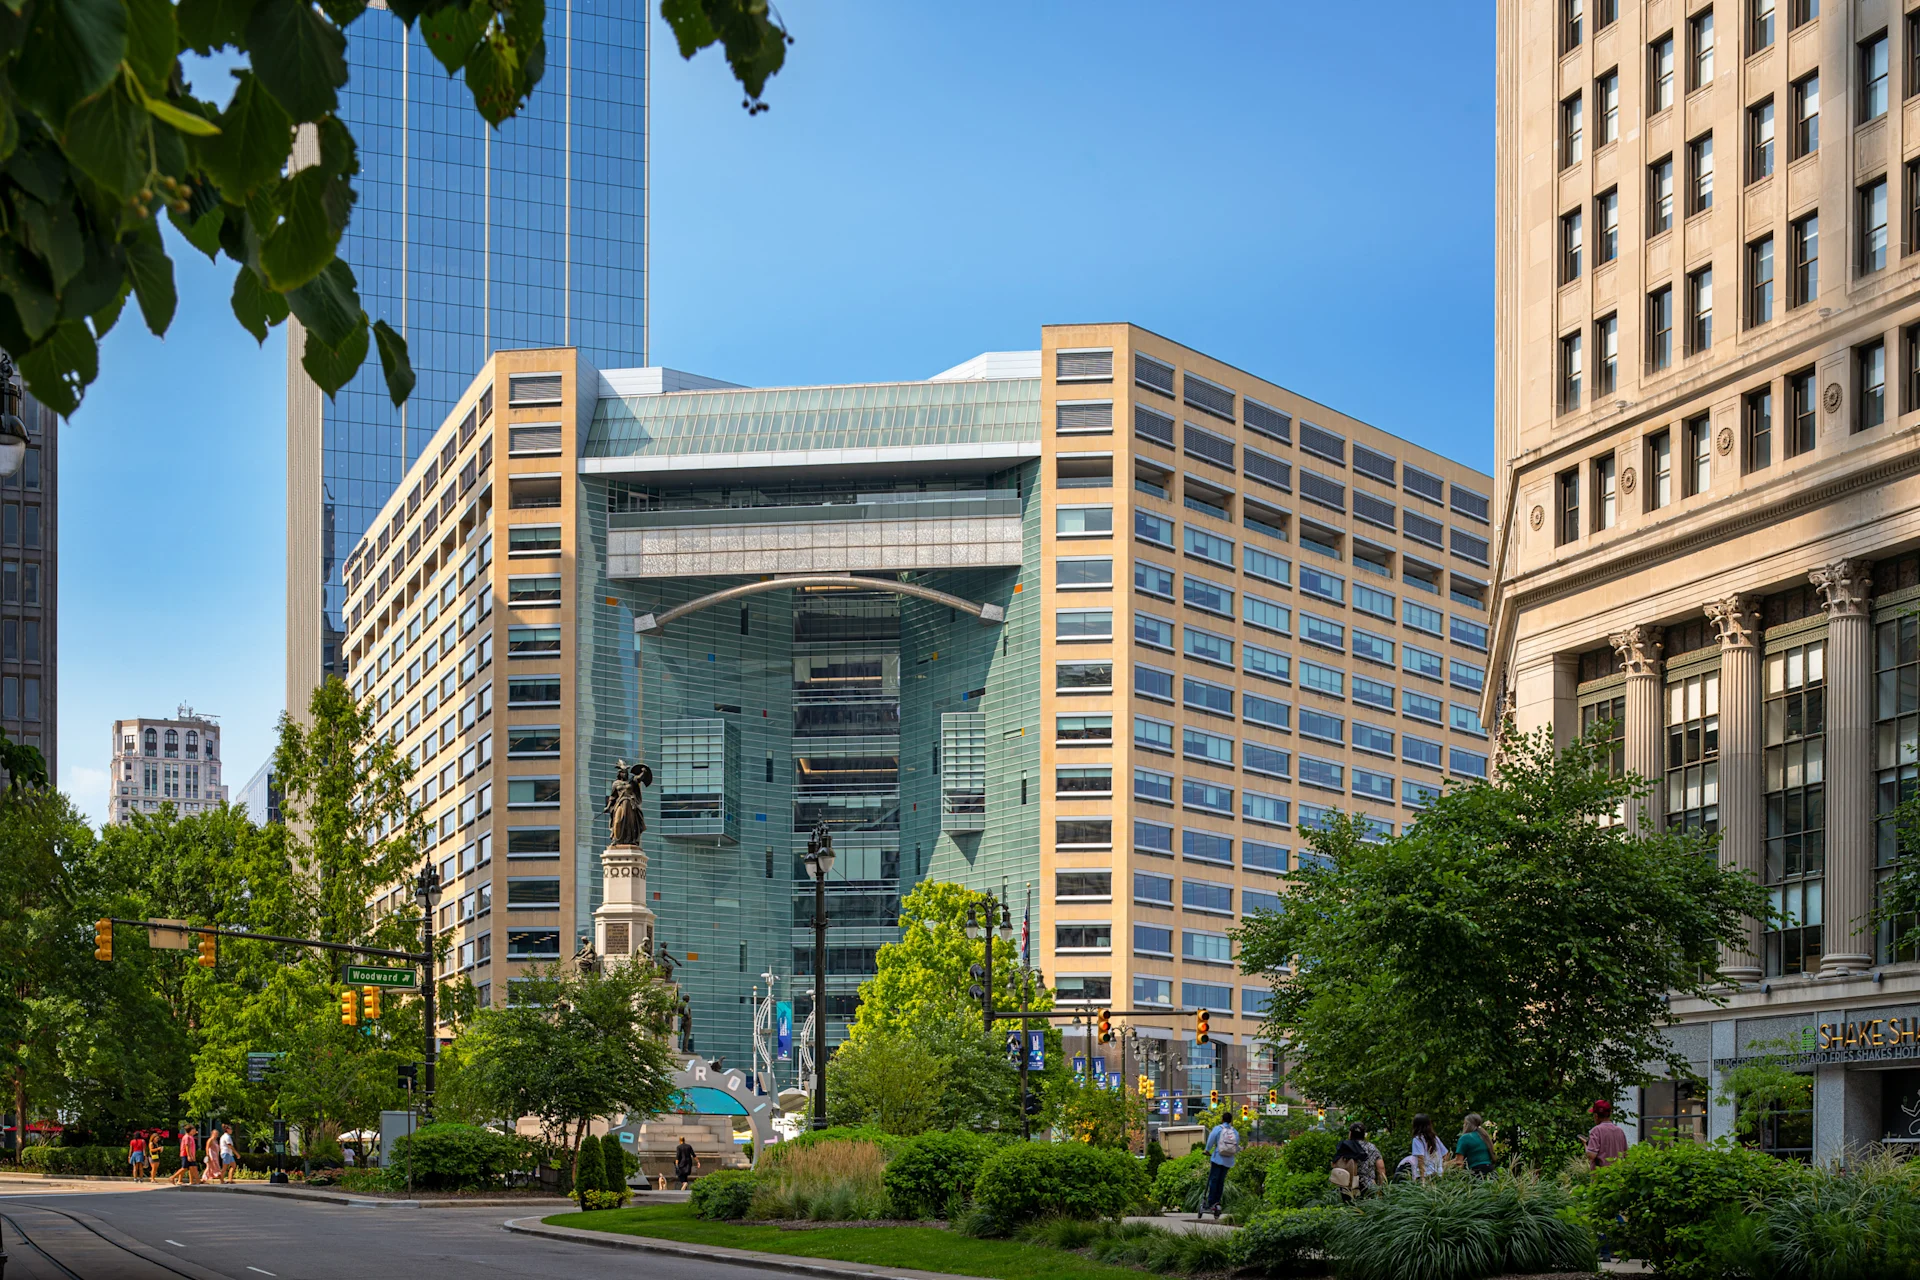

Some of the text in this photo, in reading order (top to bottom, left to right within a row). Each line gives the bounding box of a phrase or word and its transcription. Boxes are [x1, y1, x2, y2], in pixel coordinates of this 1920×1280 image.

[353, 970, 398, 981] Woodward
[1820, 1019, 1885, 1049] SHAKE
[1830, 1051, 1854, 1063] FRIES
[1857, 1048, 1892, 1061] SHAKES
[1895, 1046, 1915, 1059] HOT
